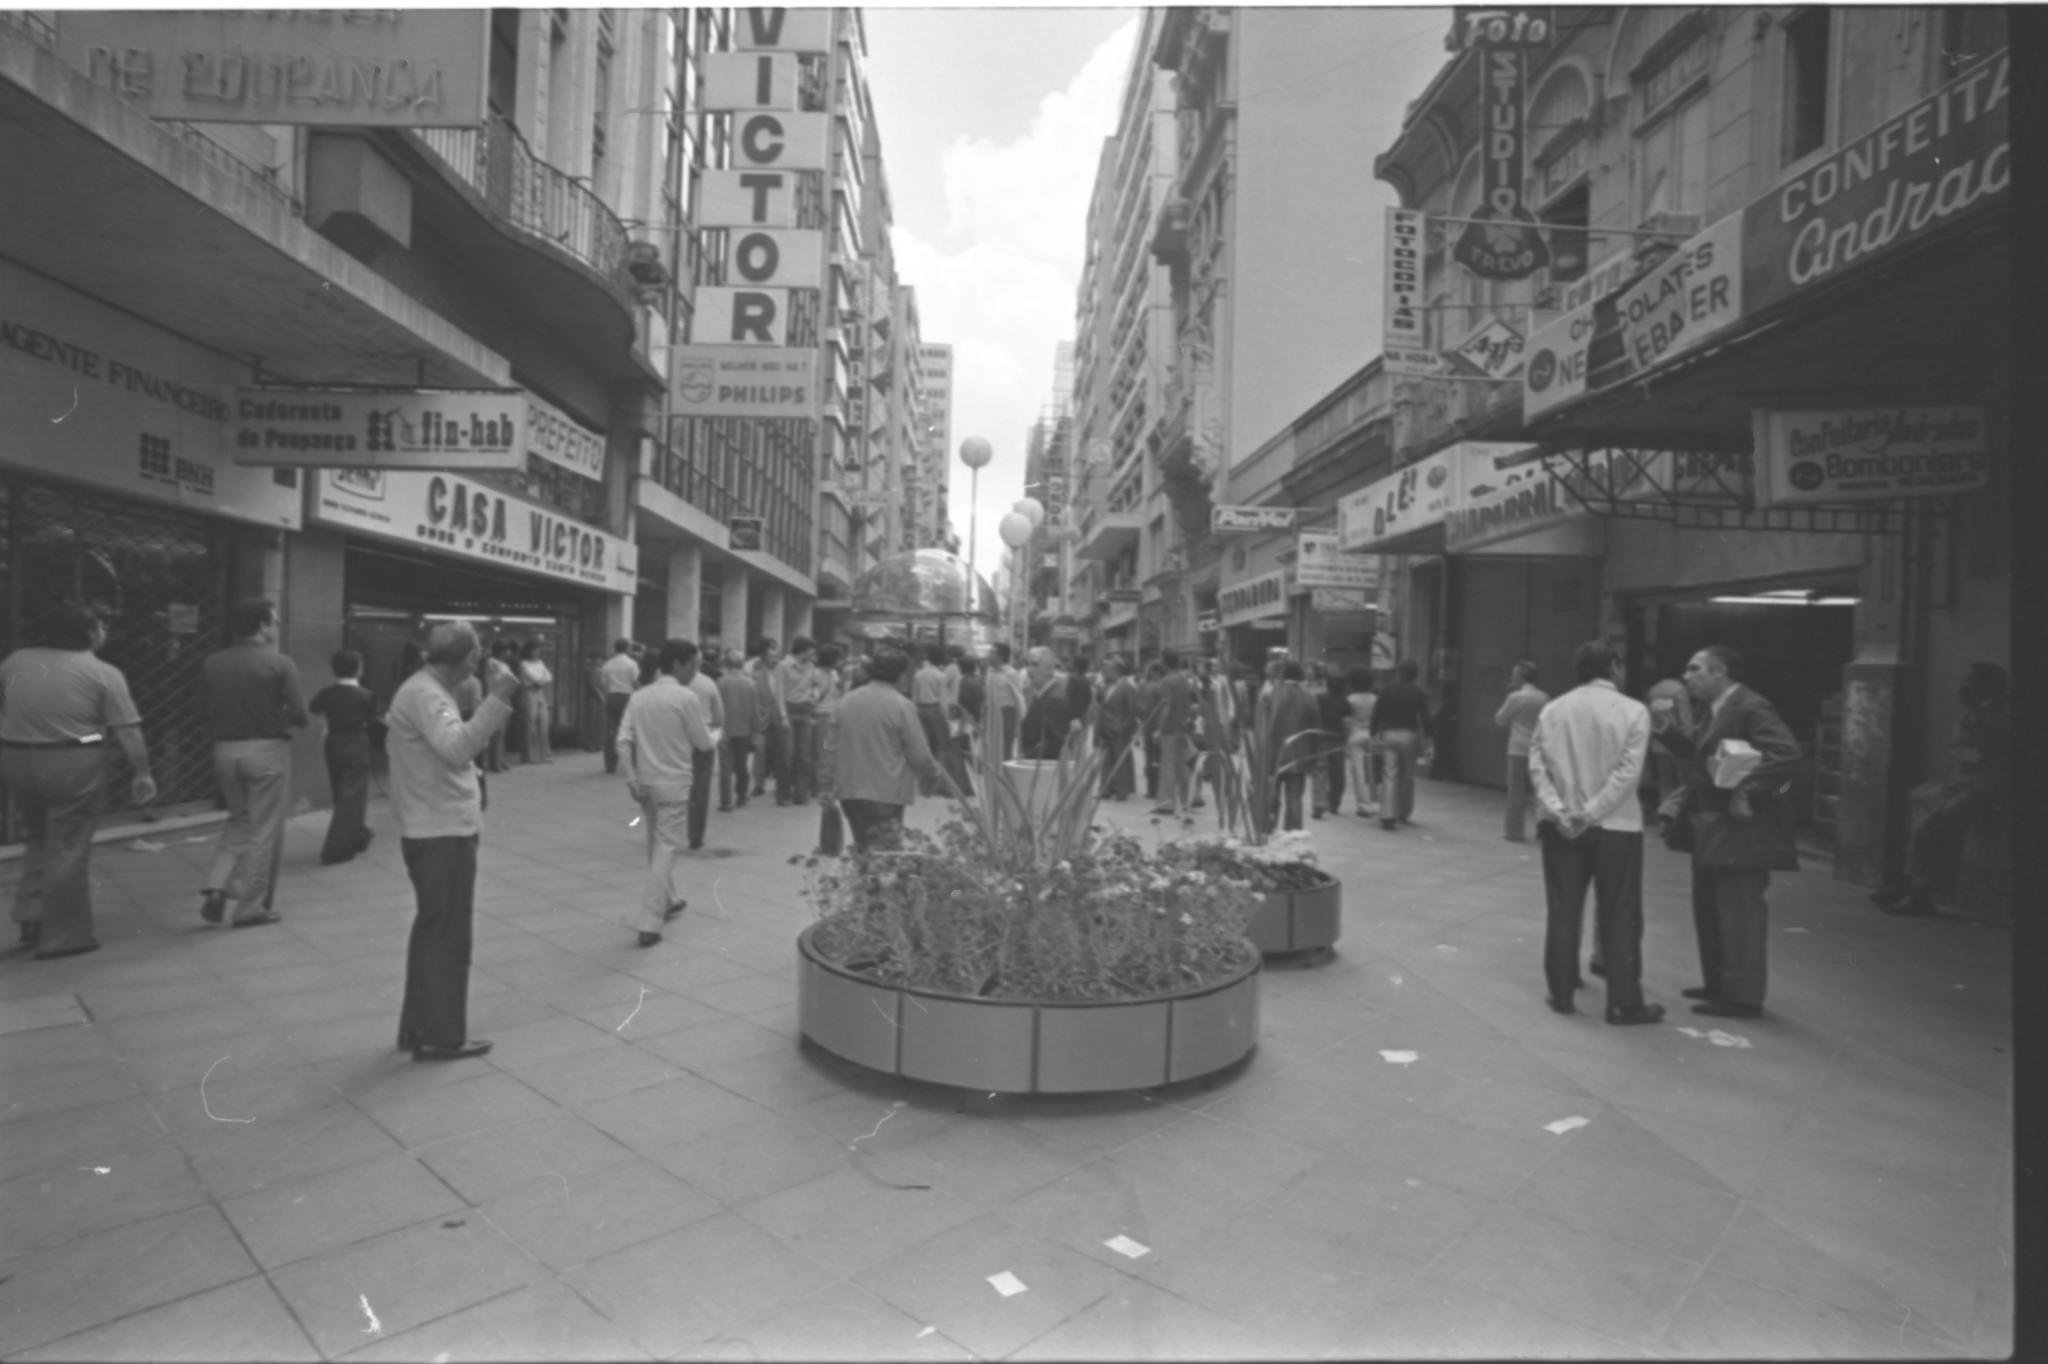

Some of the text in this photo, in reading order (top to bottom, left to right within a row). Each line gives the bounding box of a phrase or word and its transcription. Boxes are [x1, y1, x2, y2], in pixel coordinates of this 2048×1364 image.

[1465, 10, 1547, 48] Foto
[1491, 51, 1517, 214] STUDIO
[733, 8, 786, 341] VICTOR
[1393, 212, 1417, 330] FOTOCOPIAS
[0, 320, 101, 379] AGENTE
[719, 385, 806, 404] PHILIPS
[265, 428, 356, 452] Poupança
[421, 410, 513, 447] fin-hab
[528, 402, 603, 471] PREFEITO
[426, 475, 507, 543] CASA
[530, 510, 606, 571] VICTOR
